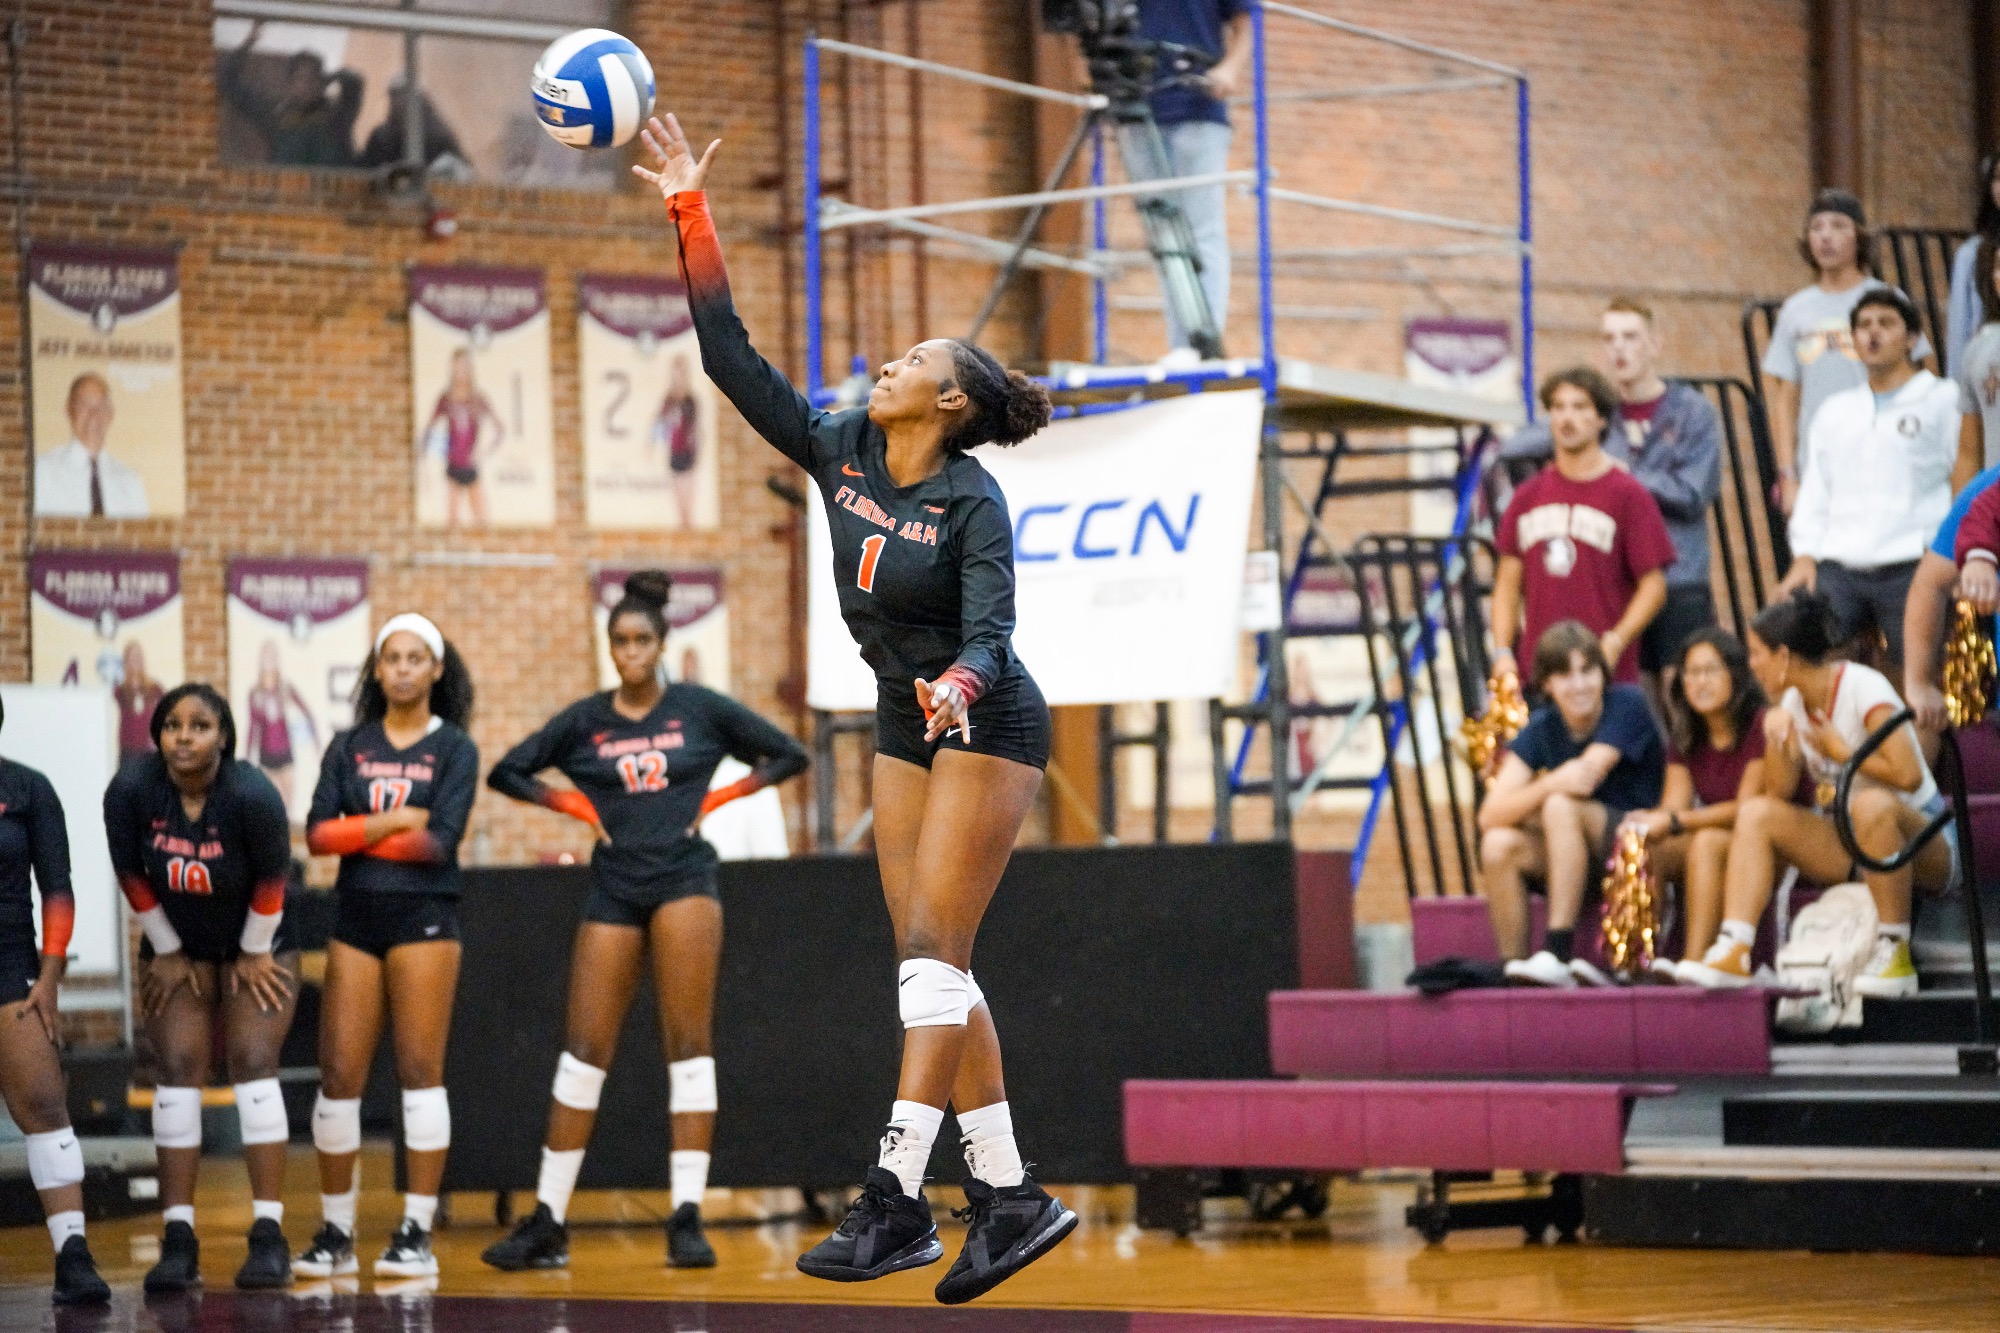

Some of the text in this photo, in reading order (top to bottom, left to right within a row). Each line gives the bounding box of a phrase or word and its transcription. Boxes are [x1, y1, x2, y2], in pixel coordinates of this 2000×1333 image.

[603, 371, 632, 439] 2
[834, 485, 938, 546] FLORIDA A&M
[1013, 491, 1203, 563] CCN
[45, 569, 169, 596] FLORIDA STATE
[856, 533, 887, 593] 1
[369, 778, 413, 813] 17
[616, 750, 669, 794] 12
